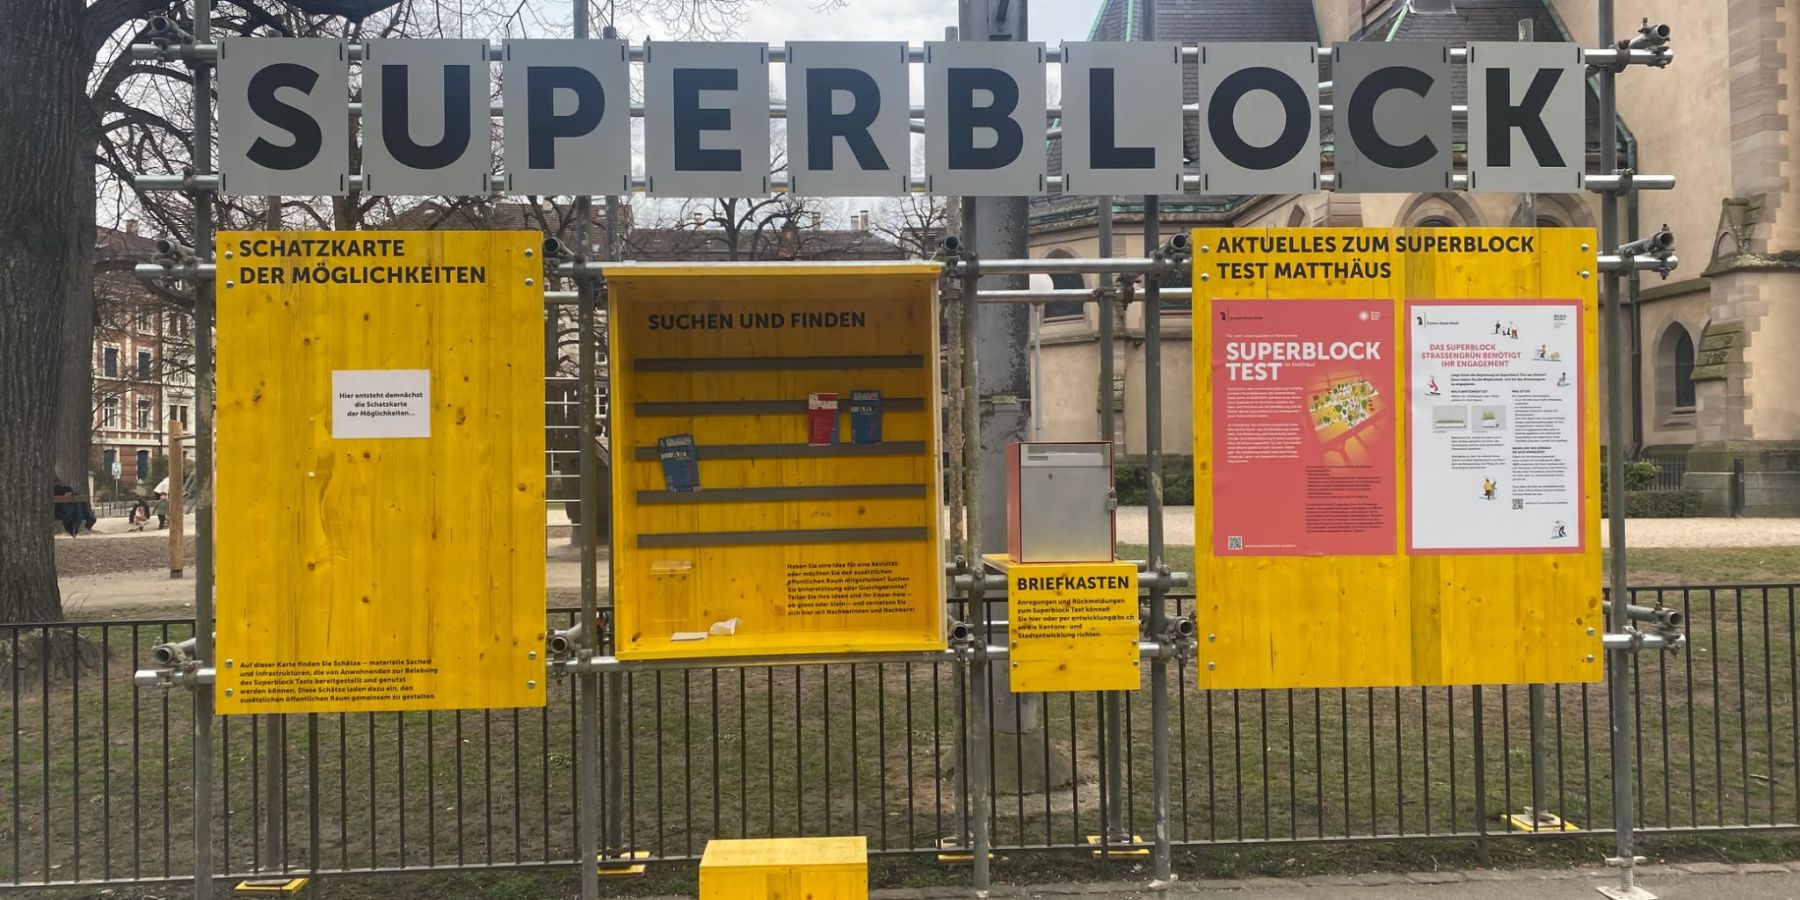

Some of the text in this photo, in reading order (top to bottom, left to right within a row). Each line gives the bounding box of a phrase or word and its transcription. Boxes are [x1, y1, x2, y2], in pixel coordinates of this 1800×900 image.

[246, 62, 1567, 171] SUPERBLOCK
[239, 240, 404, 257] SCHATZKARTE
[1217, 236, 1534, 253] AKTUELLES ZUM SUPERBLOCK
[240, 262, 485, 284] DER MÖGLICHKEITEN
[1217, 258, 1391, 279] TEST MATTHÄUS
[648, 312, 865, 330] SUCHEN UND FINDEN
[1226, 341, 1381, 360] SUPERBLOCK
[1226, 362, 1282, 381] TEST
[1018, 576, 1129, 590] BRIEFKASTEN
[315, 677, 362, 685] bereitgestellt
